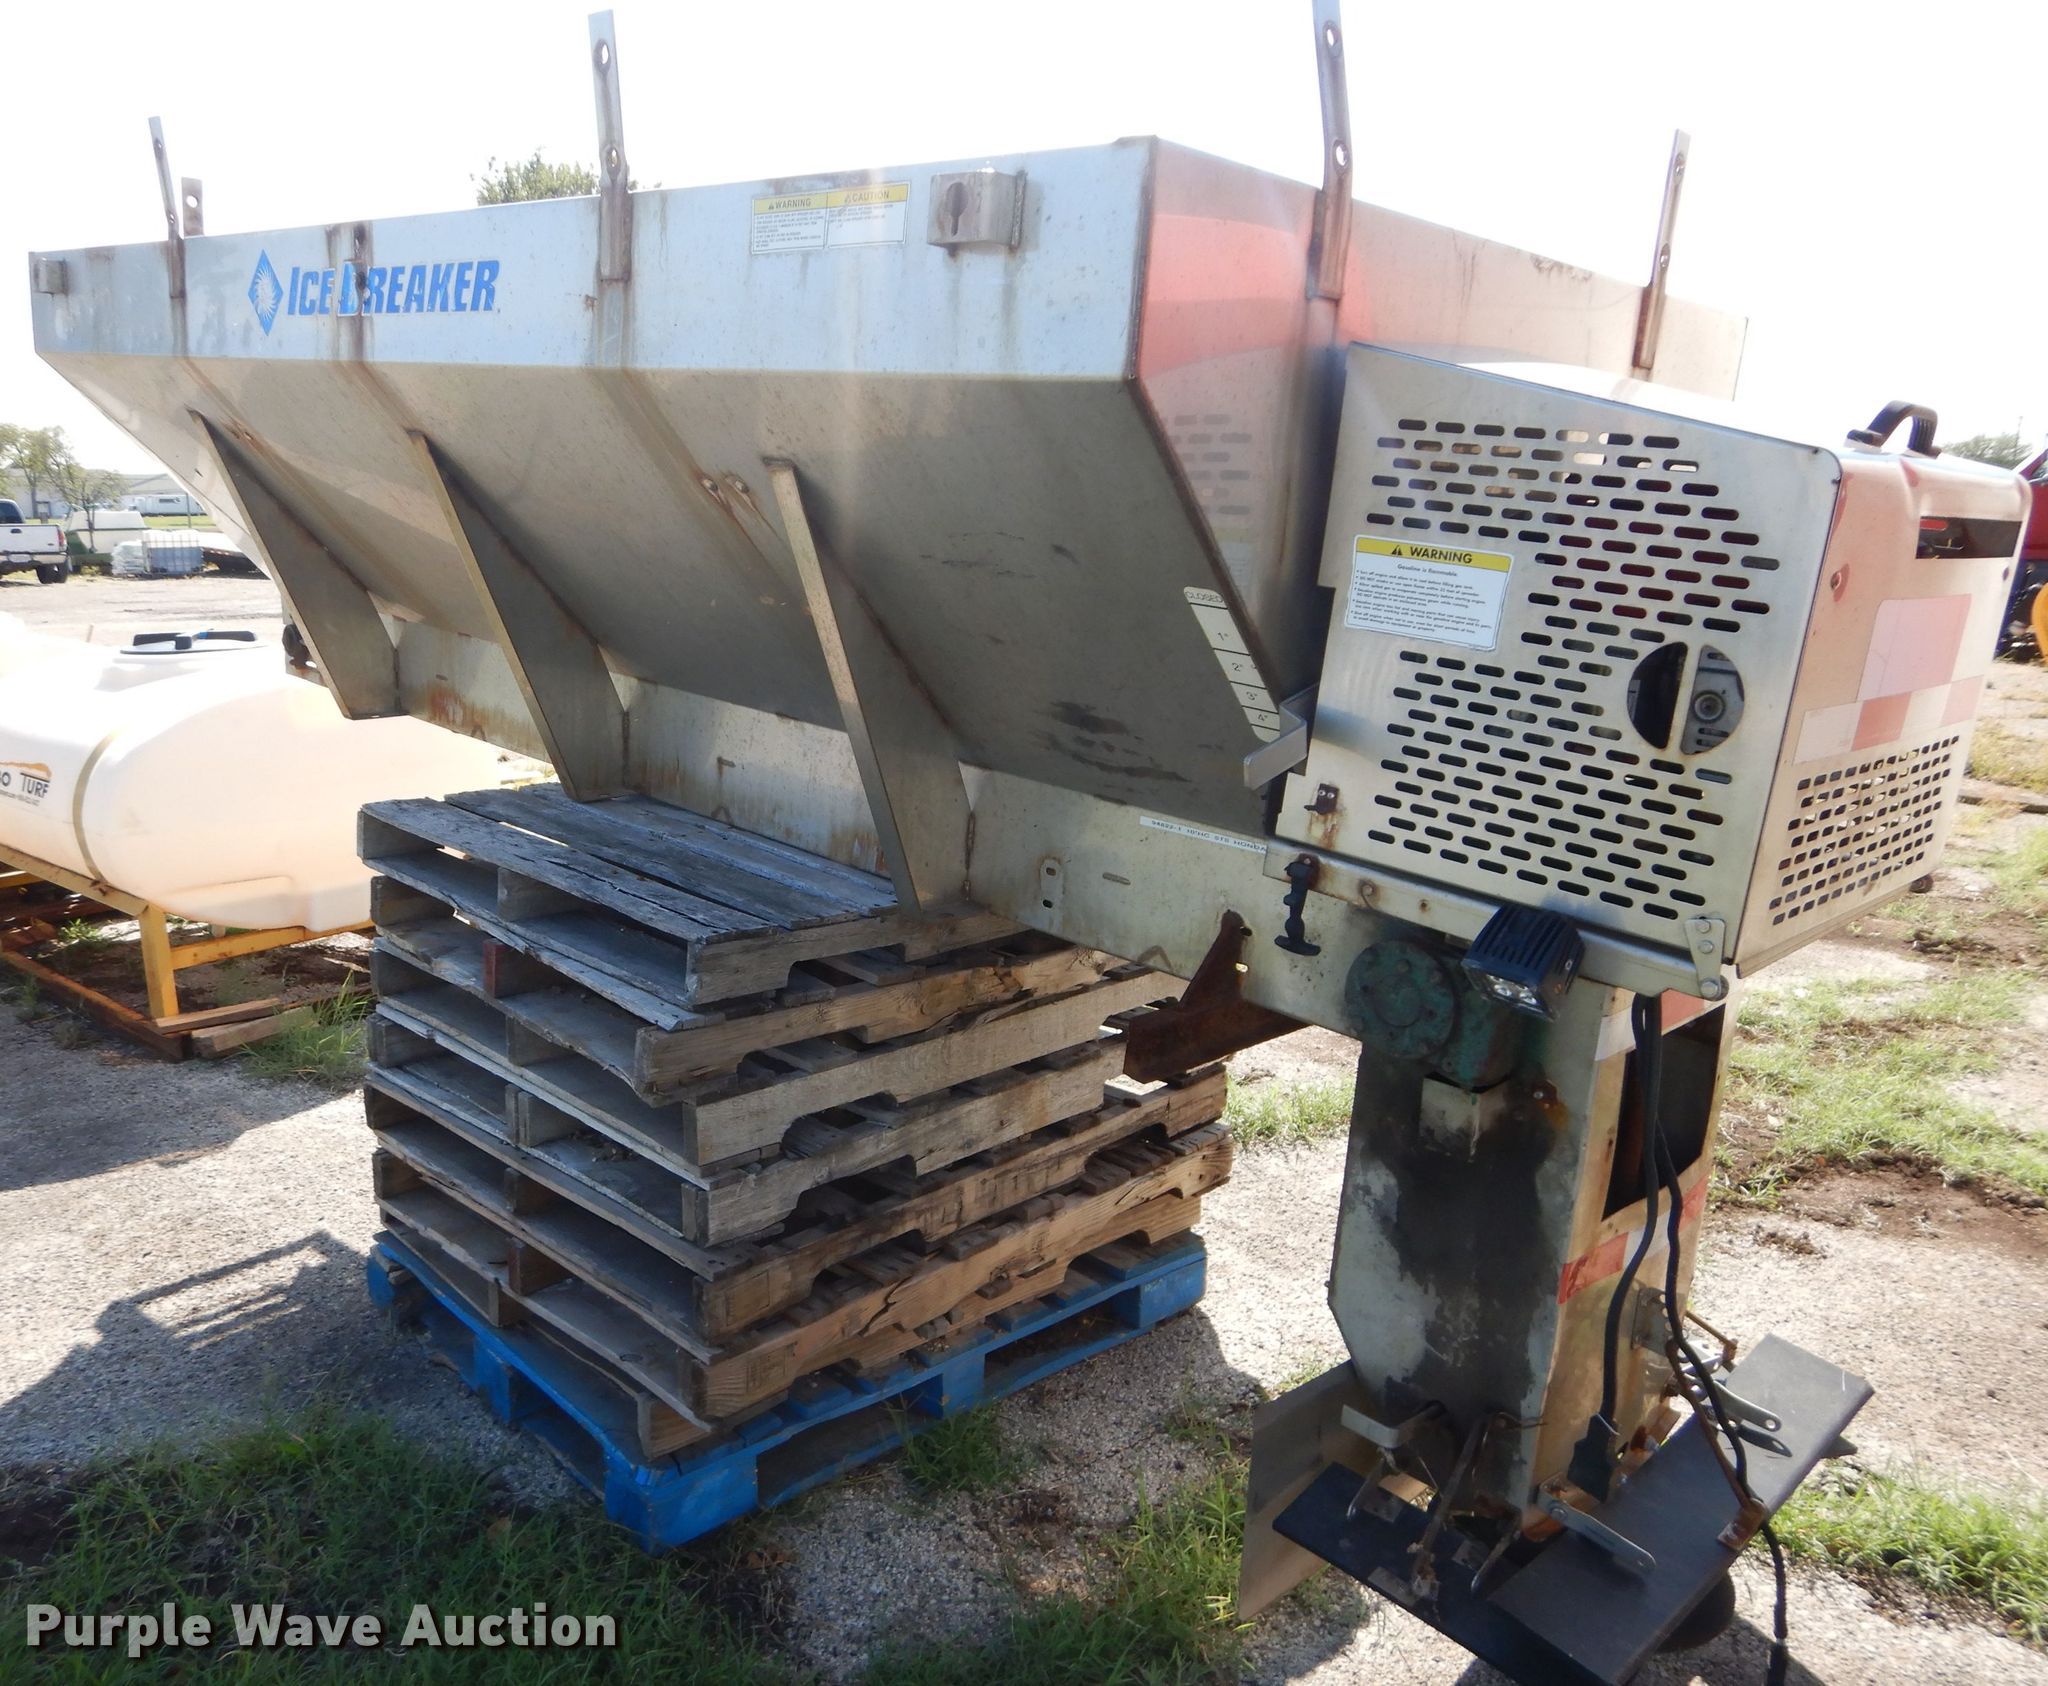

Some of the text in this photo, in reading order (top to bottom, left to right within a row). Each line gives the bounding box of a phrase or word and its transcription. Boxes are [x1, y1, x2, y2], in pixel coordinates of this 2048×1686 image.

[776, 198, 811, 209] WARNING
[852, 190, 889, 202] CAUTION
[287, 266, 335, 316] ICE
[1410, 546, 1473, 564] WARNING
[1185, 591, 1224, 603] CLOSED
[22, 776, 49, 798] TURF
